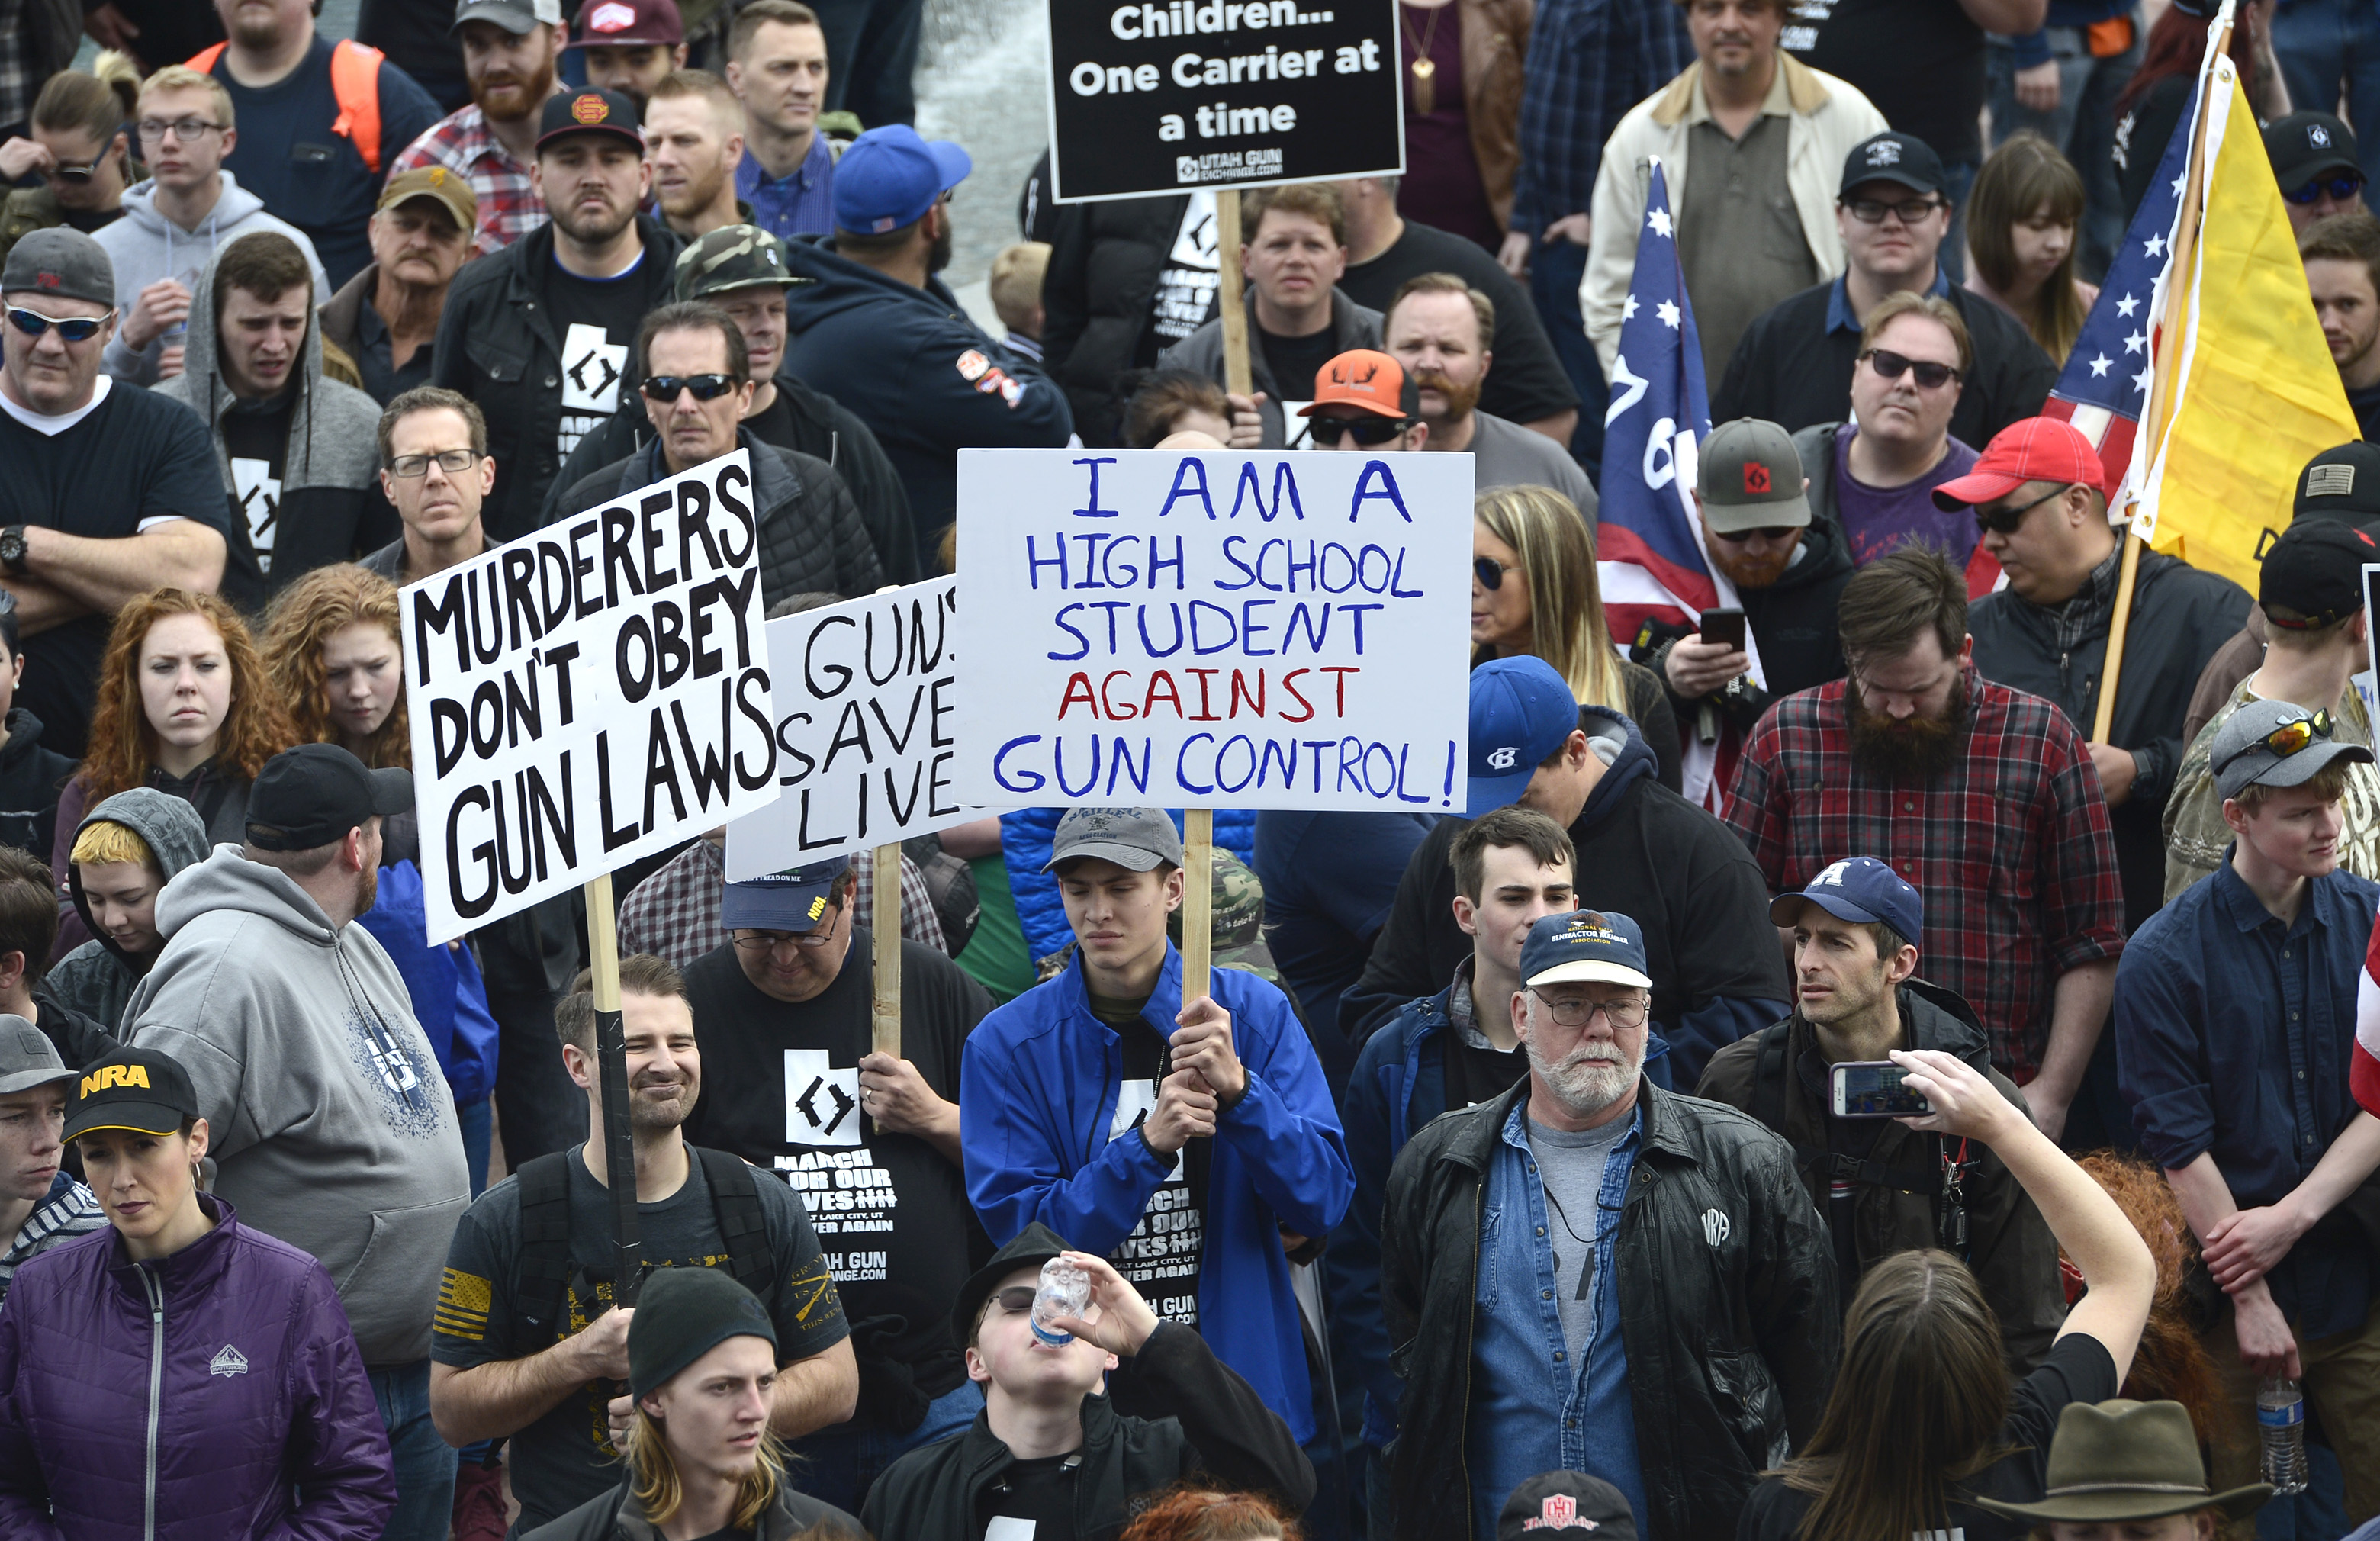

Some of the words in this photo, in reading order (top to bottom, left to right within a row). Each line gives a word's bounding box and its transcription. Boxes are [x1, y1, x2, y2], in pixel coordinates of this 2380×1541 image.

[1111, 0, 1334, 40] Children...
[1069, 61, 1160, 96] One
[1171, 45, 1324, 88] Carrier
[1334, 39, 1380, 75] at
[1158, 114, 1185, 142] a
[1195, 101, 1298, 139] time
[1199, 151, 1243, 169] UTAH
[1245, 148, 1283, 166] GUN
[1072, 458, 1119, 518] I
[1159, 457, 1304, 522] AM
[1349, 460, 1413, 522] A
[414, 465, 755, 687] MURDERERS
[1026, 532, 1184, 590] HIGH
[1214, 535, 1424, 597] SCHOOL
[1047, 600, 1384, 661] STUDENT
[430, 641, 580, 780] DON'T
[616, 567, 758, 703] OBEY
[1057, 667, 1360, 723] AGAINST
[776, 676, 954, 787] SAVE
[993, 734, 1150, 797] GUN
[1176, 732, 1455, 807] CONTROL!
[446, 751, 577, 919] GUN
[596, 668, 777, 854] LAWS
[799, 751, 987, 851] LIVE
[1079, 832, 1118, 841] ASSOCIATION
[1810, 862, 1852, 888] A
[807, 896, 828, 922] NRA
[1552, 930, 1598, 942] BENEFACTOR
[80, 1064, 151, 1100] NRA
[774, 1148, 873, 1171] MARCH
[789, 1171, 829, 1190] OR
[835, 1168, 892, 1189] OUR
[798, 1190, 855, 1211] VES
[811, 1221, 838, 1234] VER
[842, 1220, 894, 1233] AGAIN
[1152, 1208, 1201, 1234] OUR
[848, 1251, 886, 1269] GUN
[1134, 1260, 1158, 1268] LAKE
[1163, 1295, 1197, 1314] GUN
